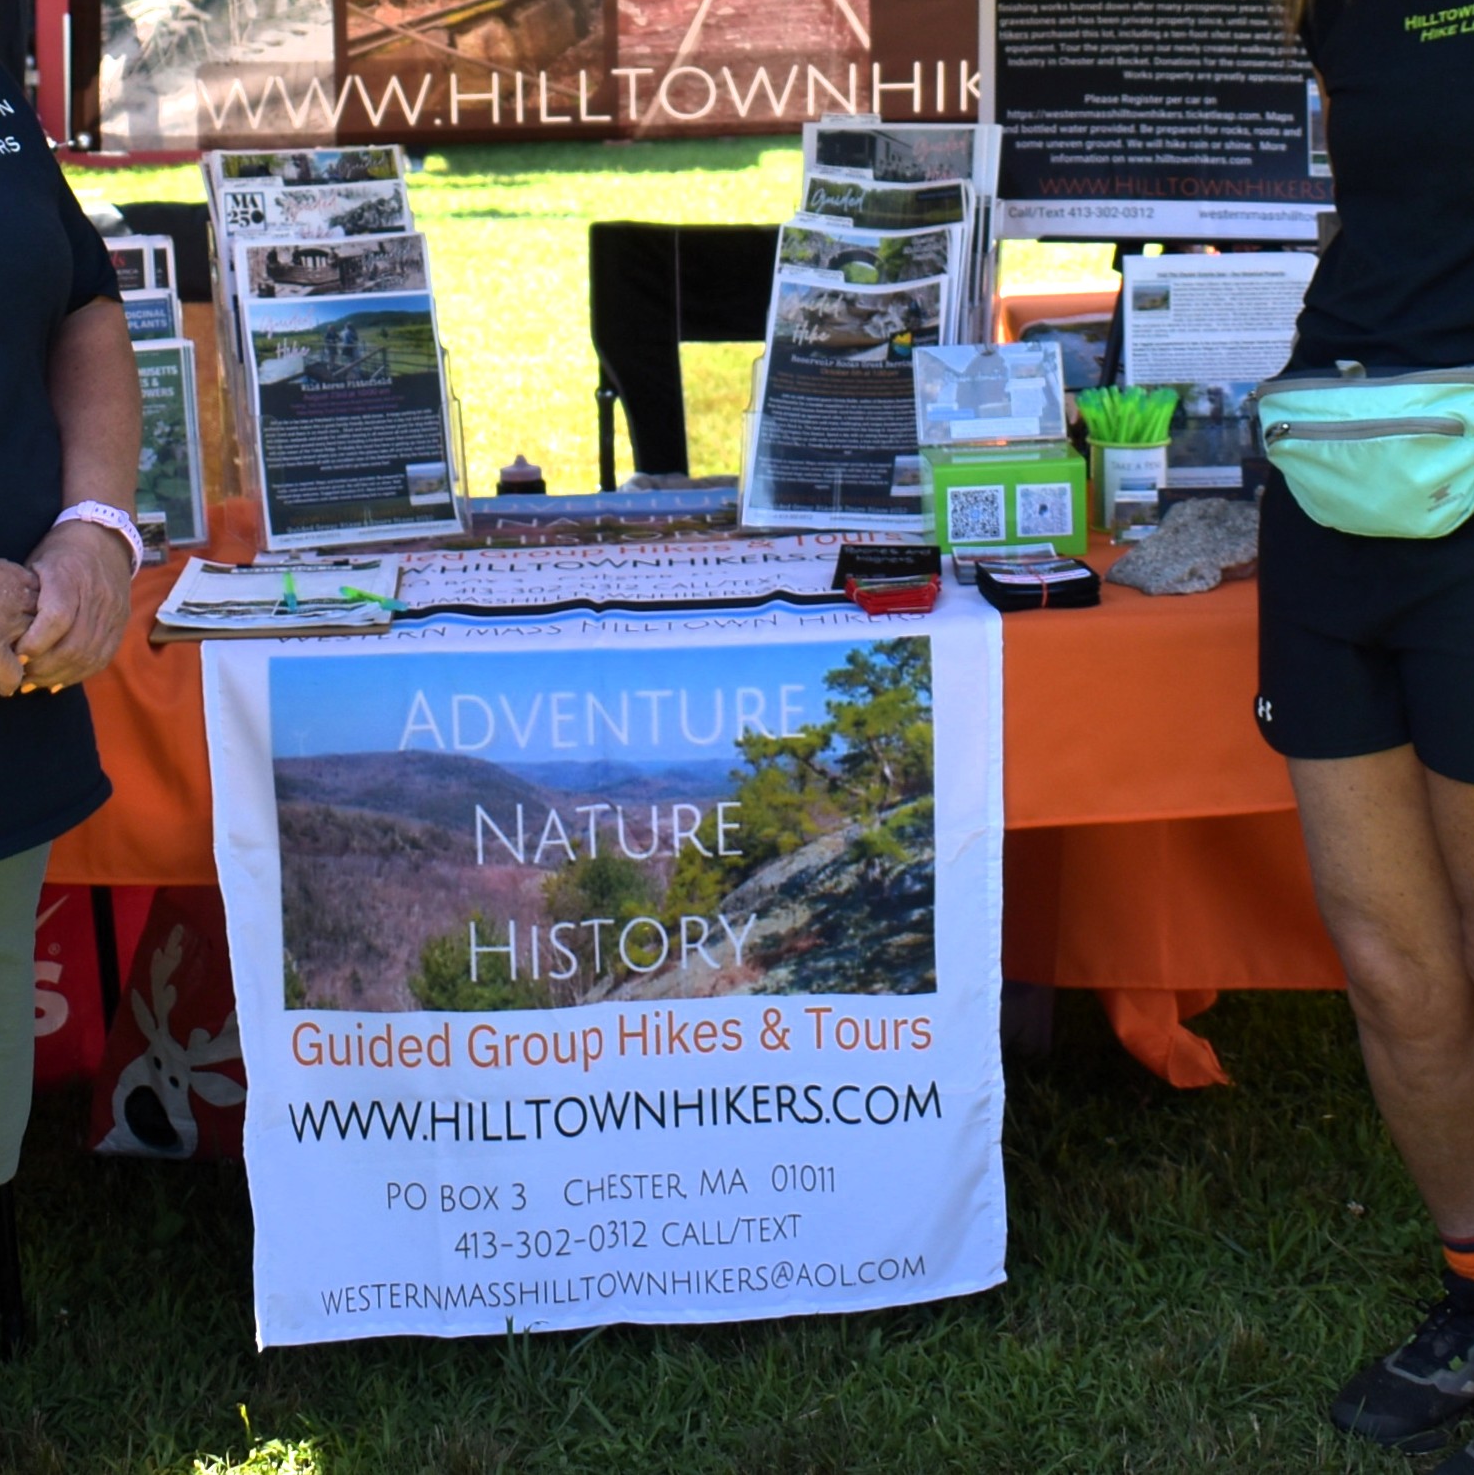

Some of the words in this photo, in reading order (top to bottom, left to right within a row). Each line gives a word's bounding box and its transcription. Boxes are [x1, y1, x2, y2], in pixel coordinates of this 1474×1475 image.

[1420, 24, 1458, 43] HIKE
[1009, 206, 1064, 219] Call/Text
[1068, 207, 1154, 218] 413-302-0312
[128, 318, 167, 330] PLANTS
[480, 548, 604, 560] Group
[620, 544, 731, 555] Hikes
[796, 530, 903, 547] Tours
[399, 682, 807, 754] ADVENTURE
[473, 801, 744, 866] NATURE
[468, 912, 759, 984] HISTORY
[291, 1019, 453, 1070] Guided
[468, 1017, 604, 1073] Group
[618, 1010, 743, 1058] Hikes
[762, 1009, 792, 1052] &
[804, 1006, 932, 1052] Tours
[288, 1082, 942, 1144] WWW.HILLTOWNHIKERS.COM
[386, 1181, 427, 1212] PO
[440, 1181, 500, 1213] BOX
[510, 1181, 528, 1212] 3
[701, 1169, 749, 1198] MA
[771, 1166, 836, 1196] 01011
[454, 1220, 648, 1261] 413-302-0312
[661, 1213, 803, 1249] CALL/TEXT
[321, 1253, 927, 1319] WESTERNMASSHILLTOWNHIKERS@AOL.COM
